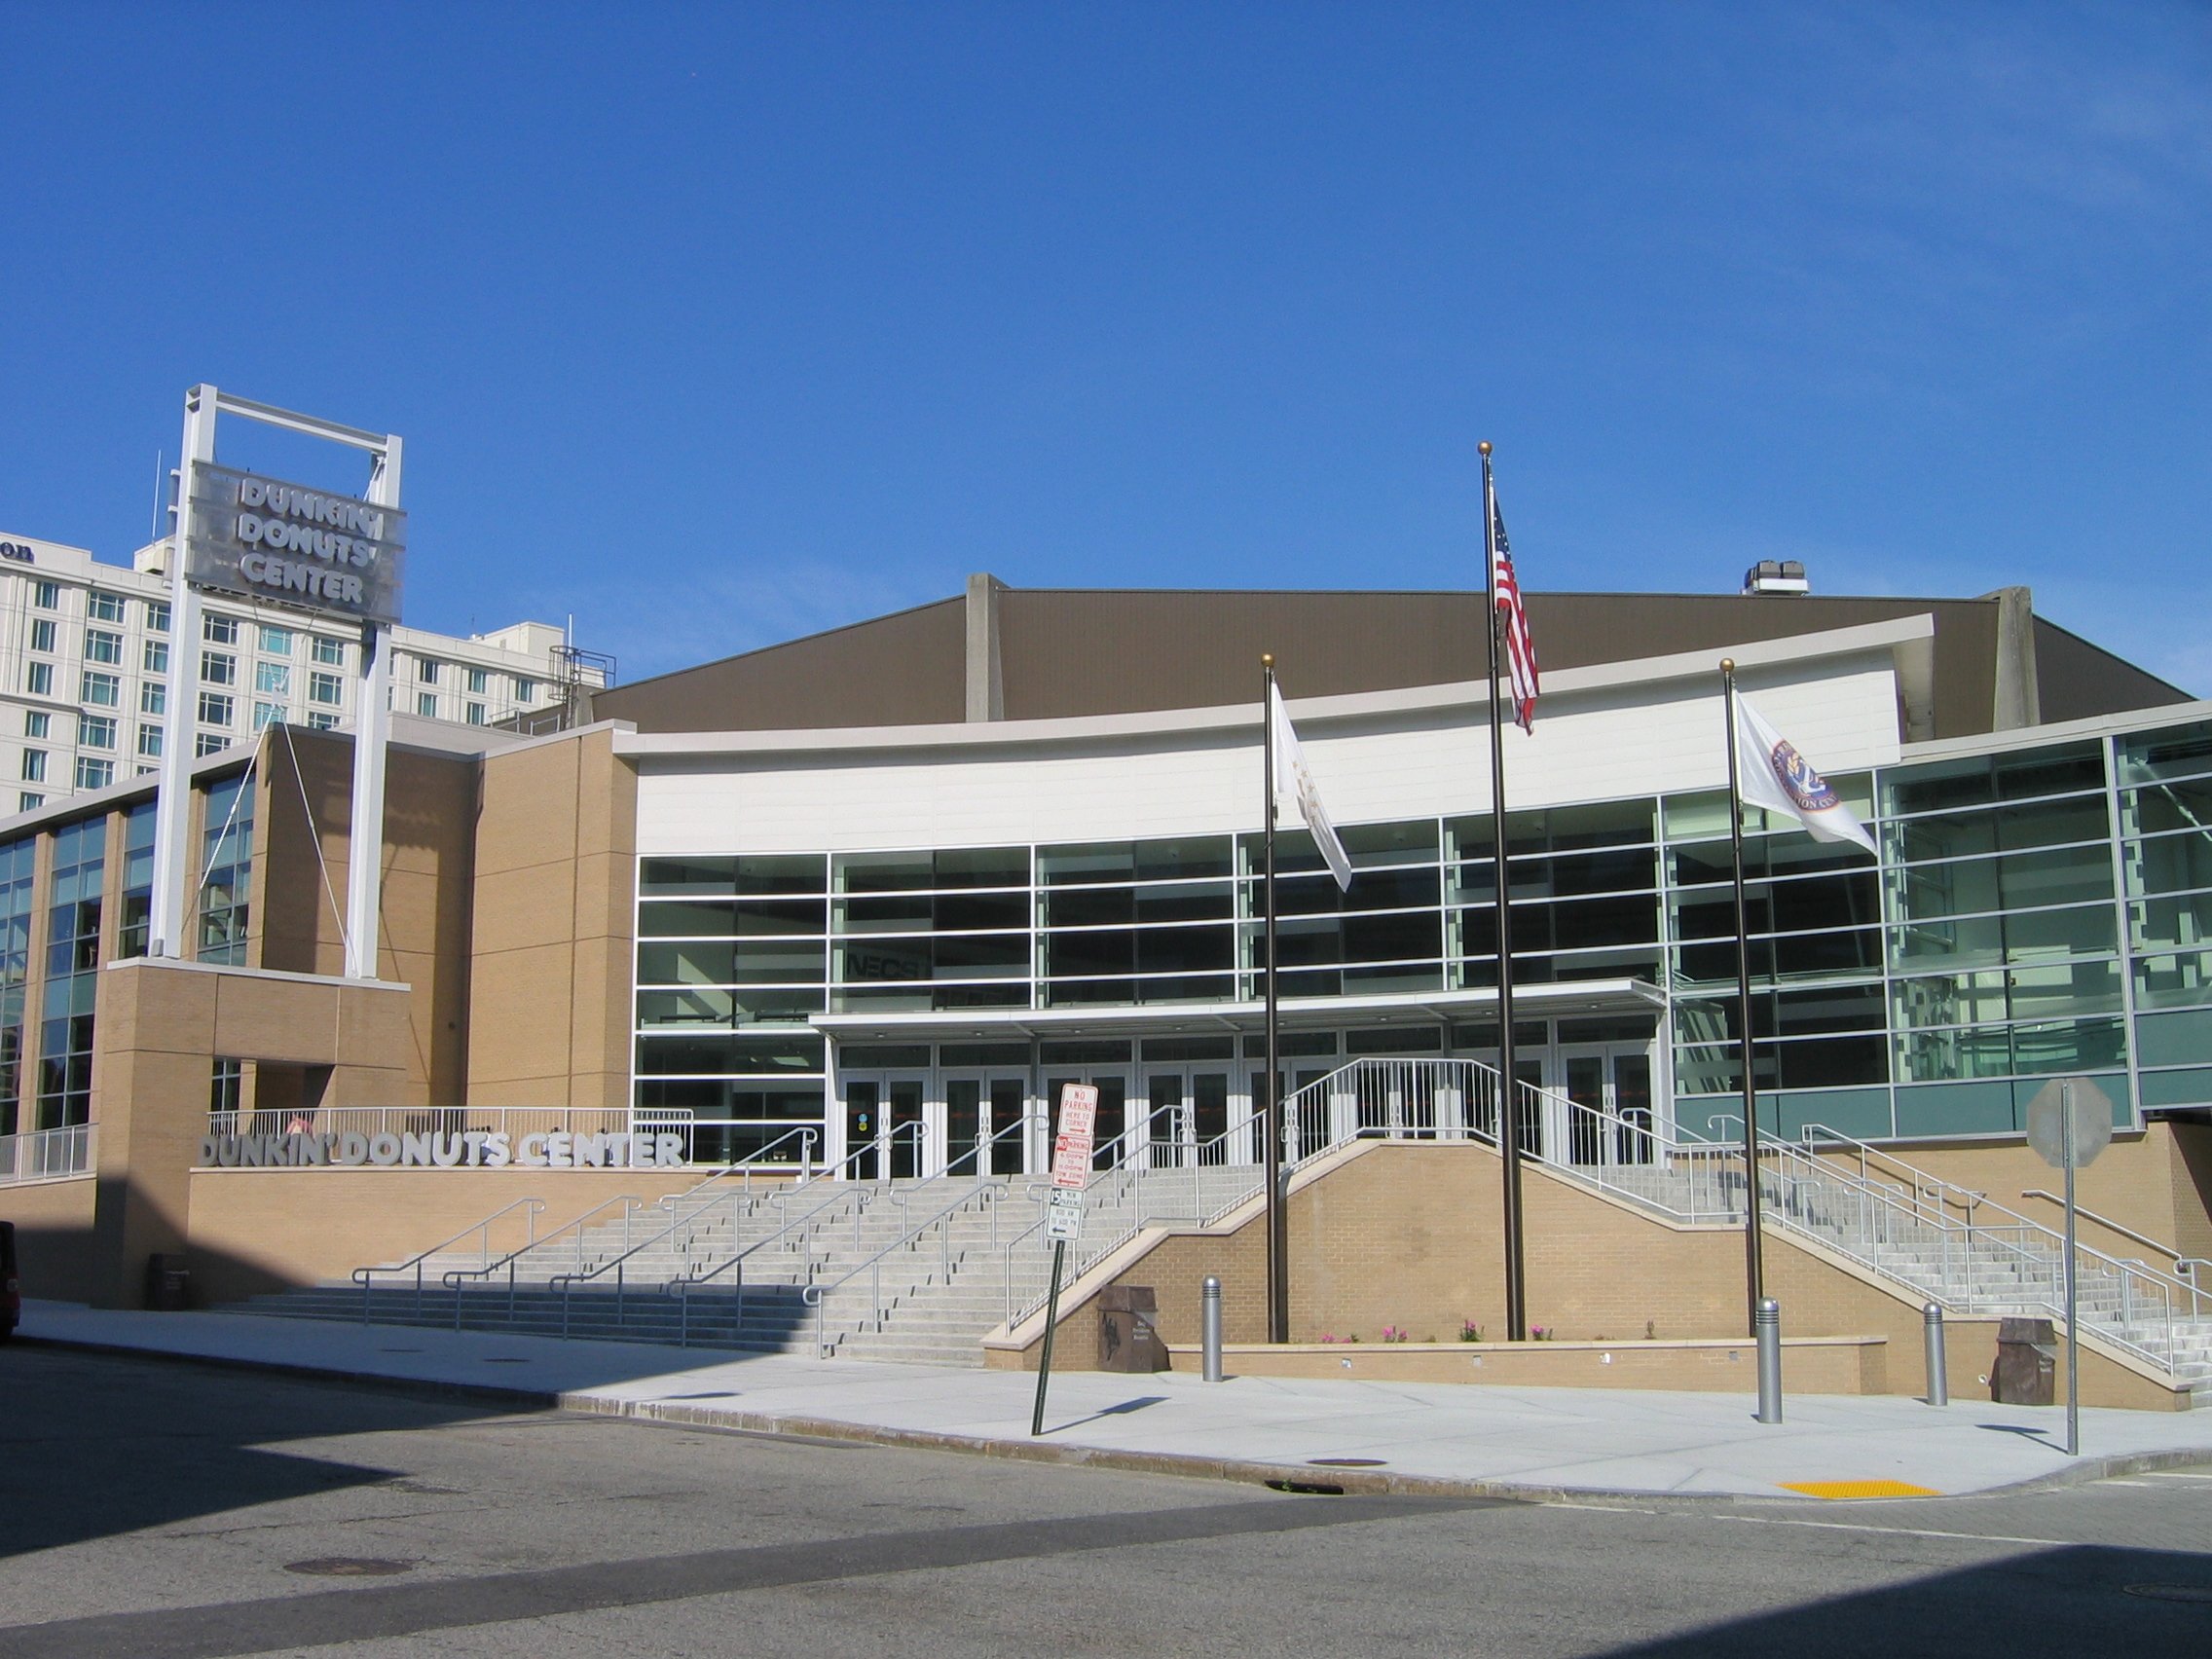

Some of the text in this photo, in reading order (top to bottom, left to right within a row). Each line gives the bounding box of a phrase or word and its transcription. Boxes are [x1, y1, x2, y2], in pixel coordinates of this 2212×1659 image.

[239, 513, 370, 568] DONUTS
[241, 553, 363, 605] CENTER
[1064, 1100, 1092, 1111] PARKING
[1075, 1091, 1086, 1100] NO
[201, 1131, 683, 1167] DUNKIN' DONUTS CENTER
[1051, 1190, 1061, 1204] 15
